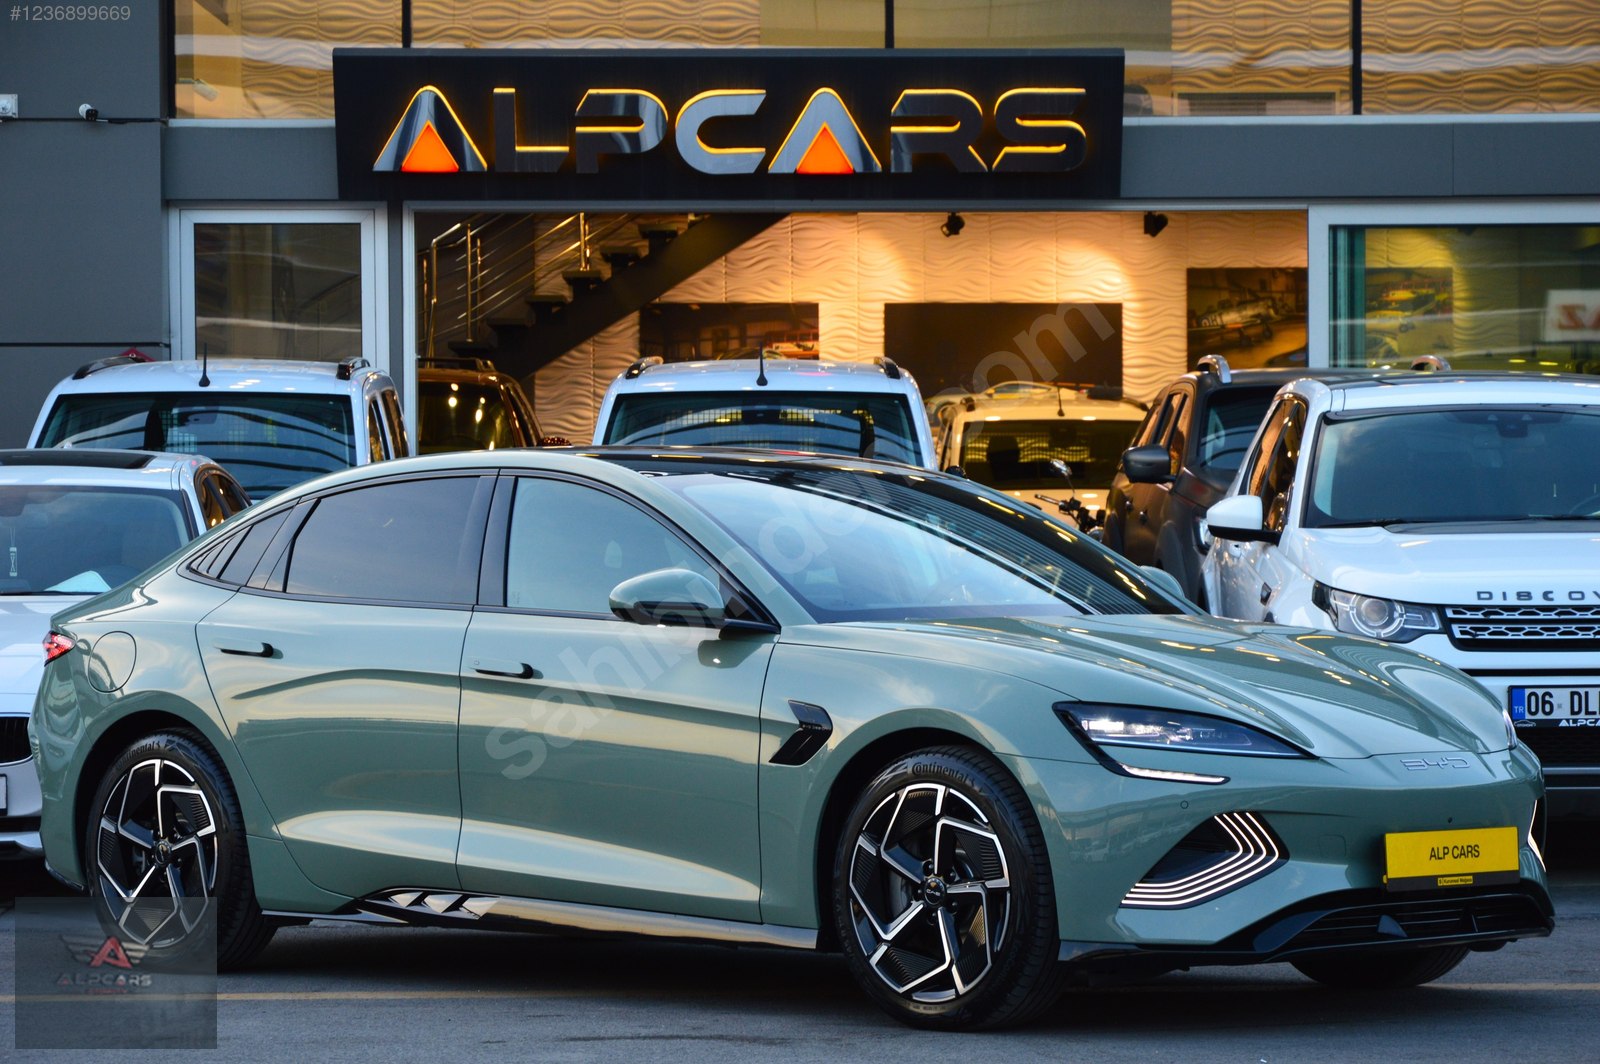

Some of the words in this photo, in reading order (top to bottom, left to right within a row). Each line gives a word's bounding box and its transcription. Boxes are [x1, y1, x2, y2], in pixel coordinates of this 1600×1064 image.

[372, 85, 1087, 175] ALPCARS
[1527, 691, 1554, 716] 06
[1570, 691, 1600, 716] DL
[912, 762, 968, 784] Continental
[1400, 757, 1470, 771] BYD
[1429, 846, 1449, 860] ALP
[1451, 844, 1480, 859] CARS
